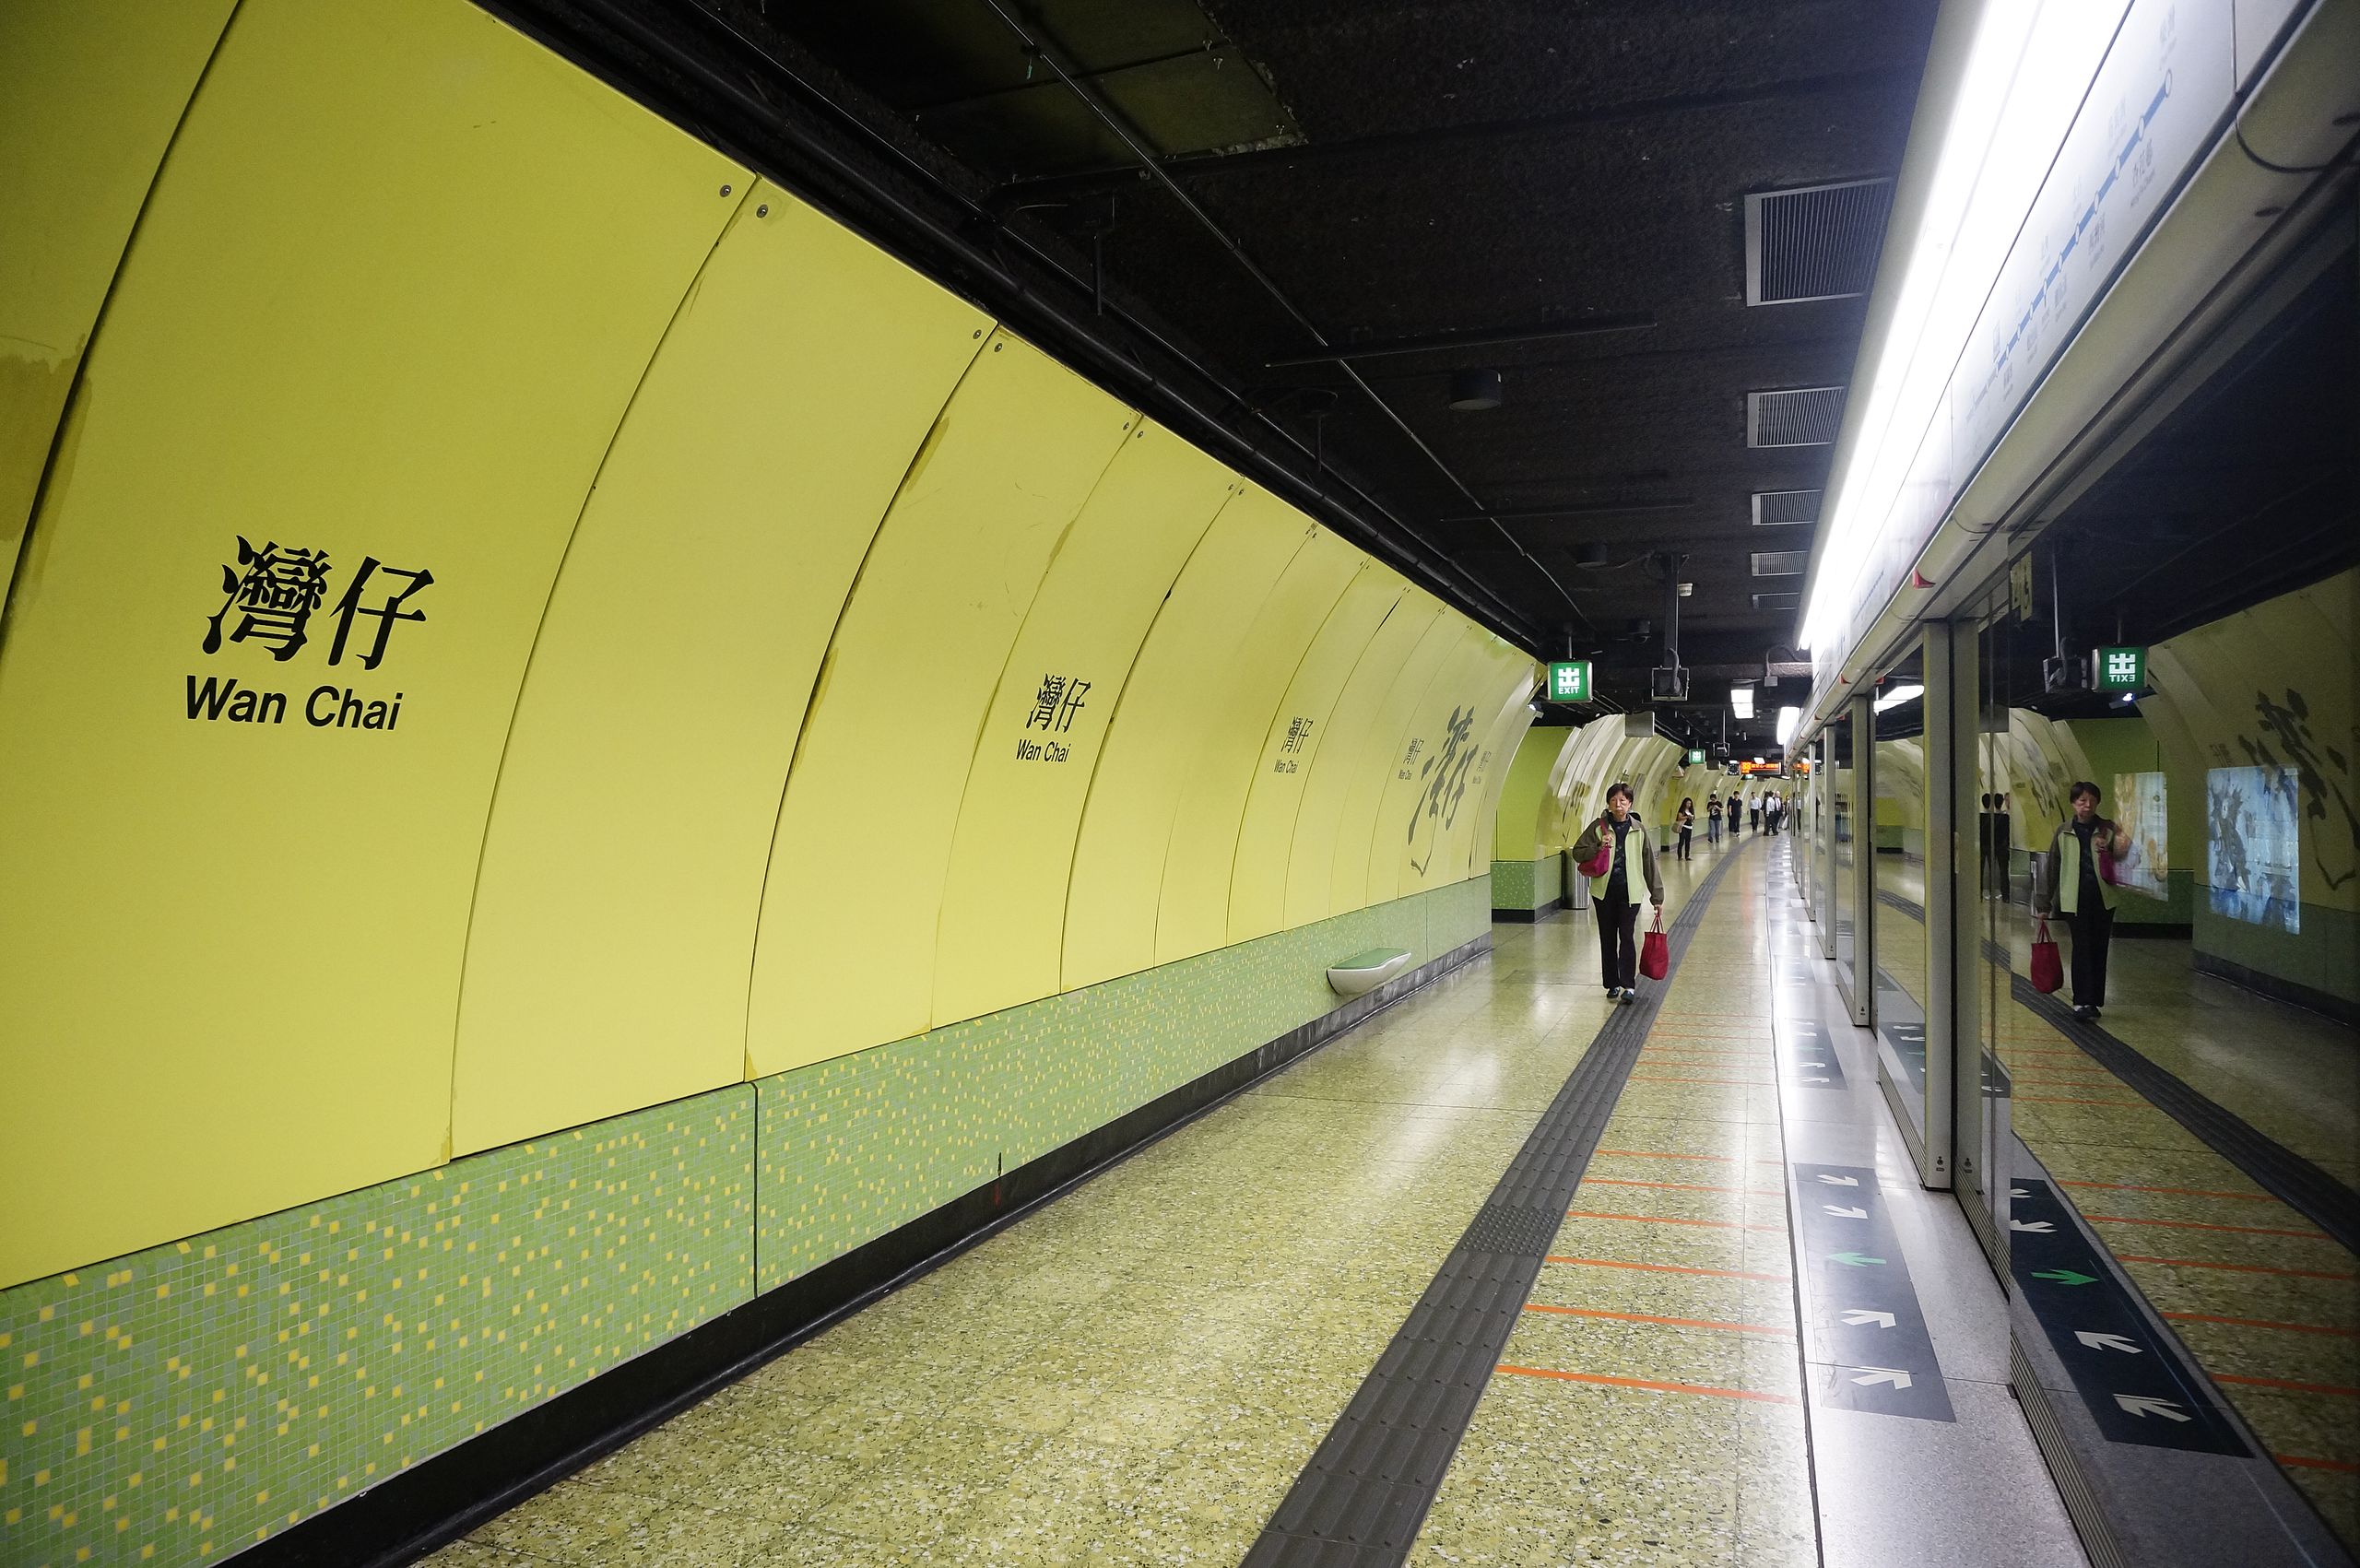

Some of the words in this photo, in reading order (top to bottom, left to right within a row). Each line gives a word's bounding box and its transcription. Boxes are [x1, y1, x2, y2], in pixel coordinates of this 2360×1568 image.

[202, 535, 435, 671] 灣仔
[1558, 667, 1580, 687] 出
[186, 674, 288, 725] Wan
[305, 685, 404, 731] Chai
[1025, 673, 1092, 734] 灣仔
[1016, 738, 1042, 761] Wan
[1044, 740, 1072, 763] Chai
[1280, 716, 1314, 754] 灣仔
